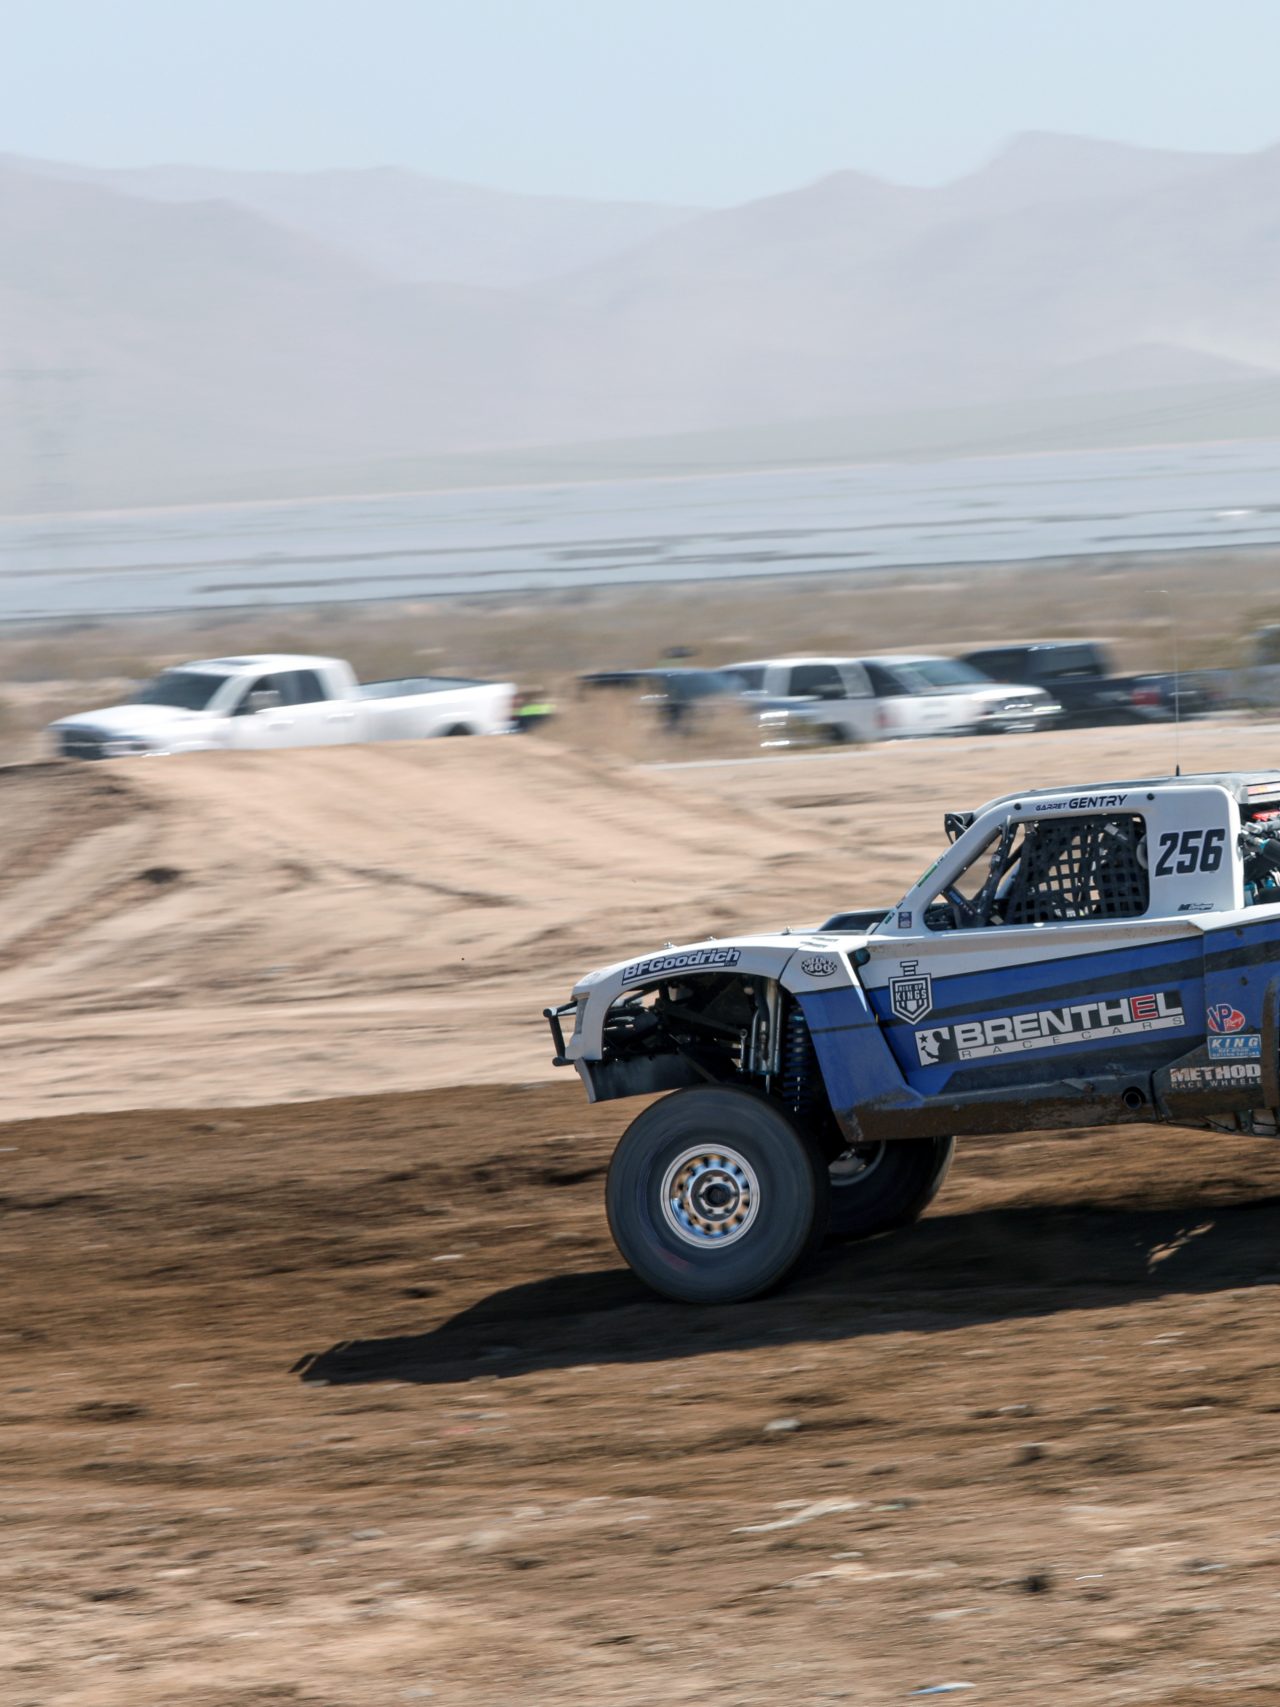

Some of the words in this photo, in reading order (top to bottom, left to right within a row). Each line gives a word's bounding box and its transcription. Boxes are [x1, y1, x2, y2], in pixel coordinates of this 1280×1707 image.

[1035, 802, 1067, 811] GARRET
[1068, 794, 1128, 809] GENTRY
[1155, 828, 1226, 877] 256
[623, 948, 740, 980] BFGoodrich
[896, 989, 927, 1001] KINGS
[954, 992, 1183, 1050] BRENTHEL
[1206, 1004, 1233, 1033] VP
[1211, 1037, 1259, 1048] KING
[1170, 1064, 1261, 1082] METHOD
